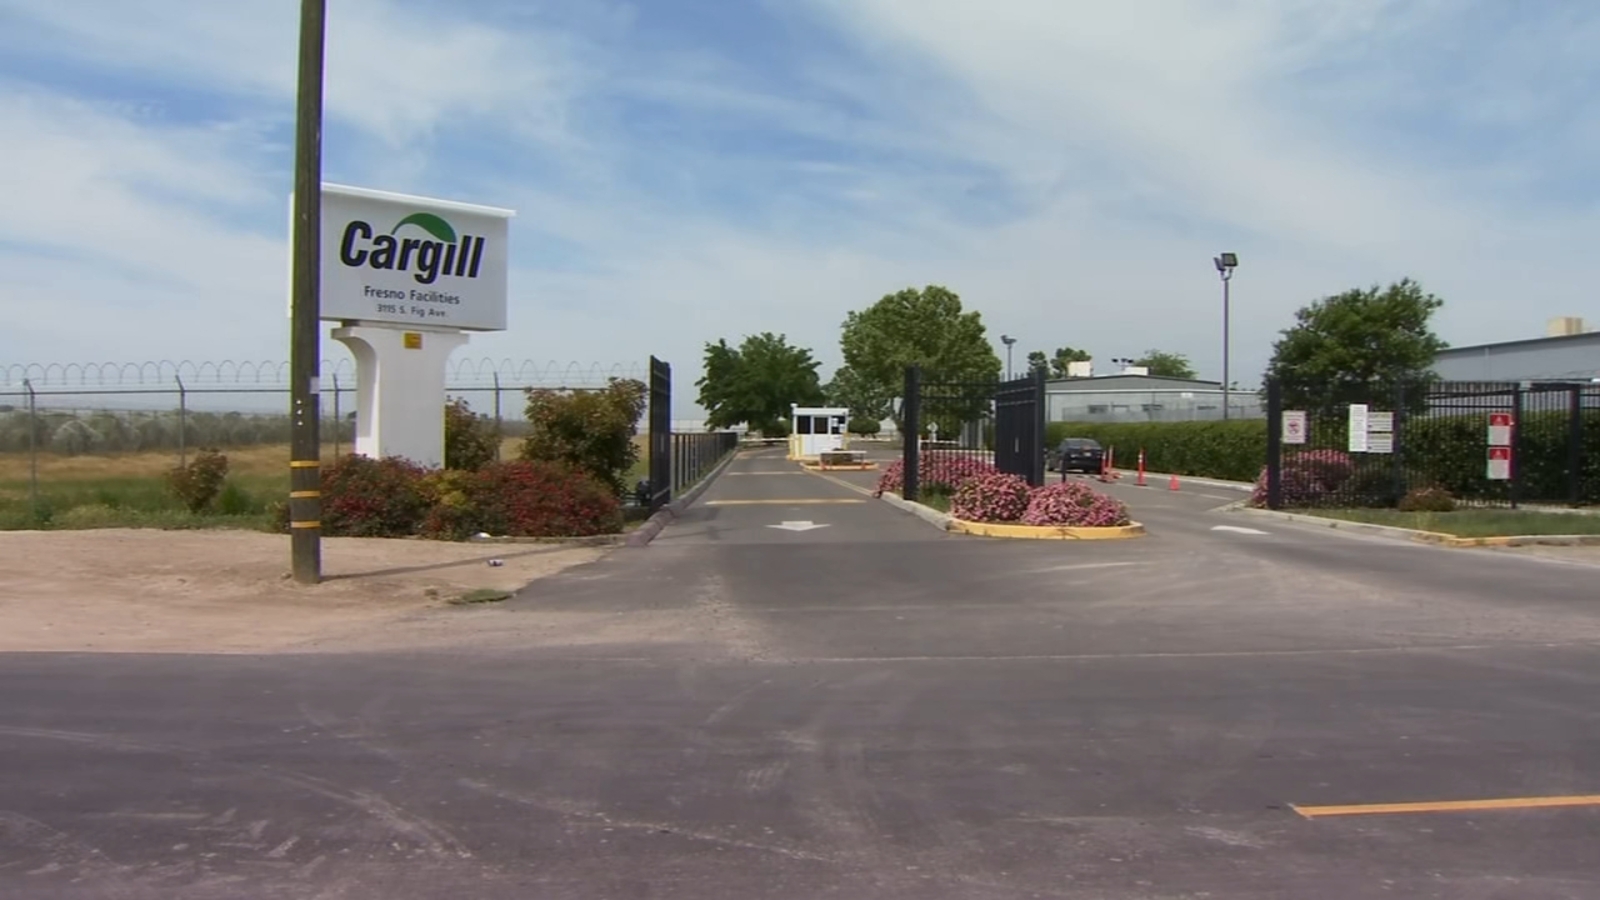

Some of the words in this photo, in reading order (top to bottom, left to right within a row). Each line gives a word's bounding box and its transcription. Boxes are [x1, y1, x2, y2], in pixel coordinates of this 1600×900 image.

[340, 220, 485, 284] Cargill
[364, 285, 406, 300] Fresno
[410, 289, 460, 305] Facilities
[411, 306, 426, 318] Fig
